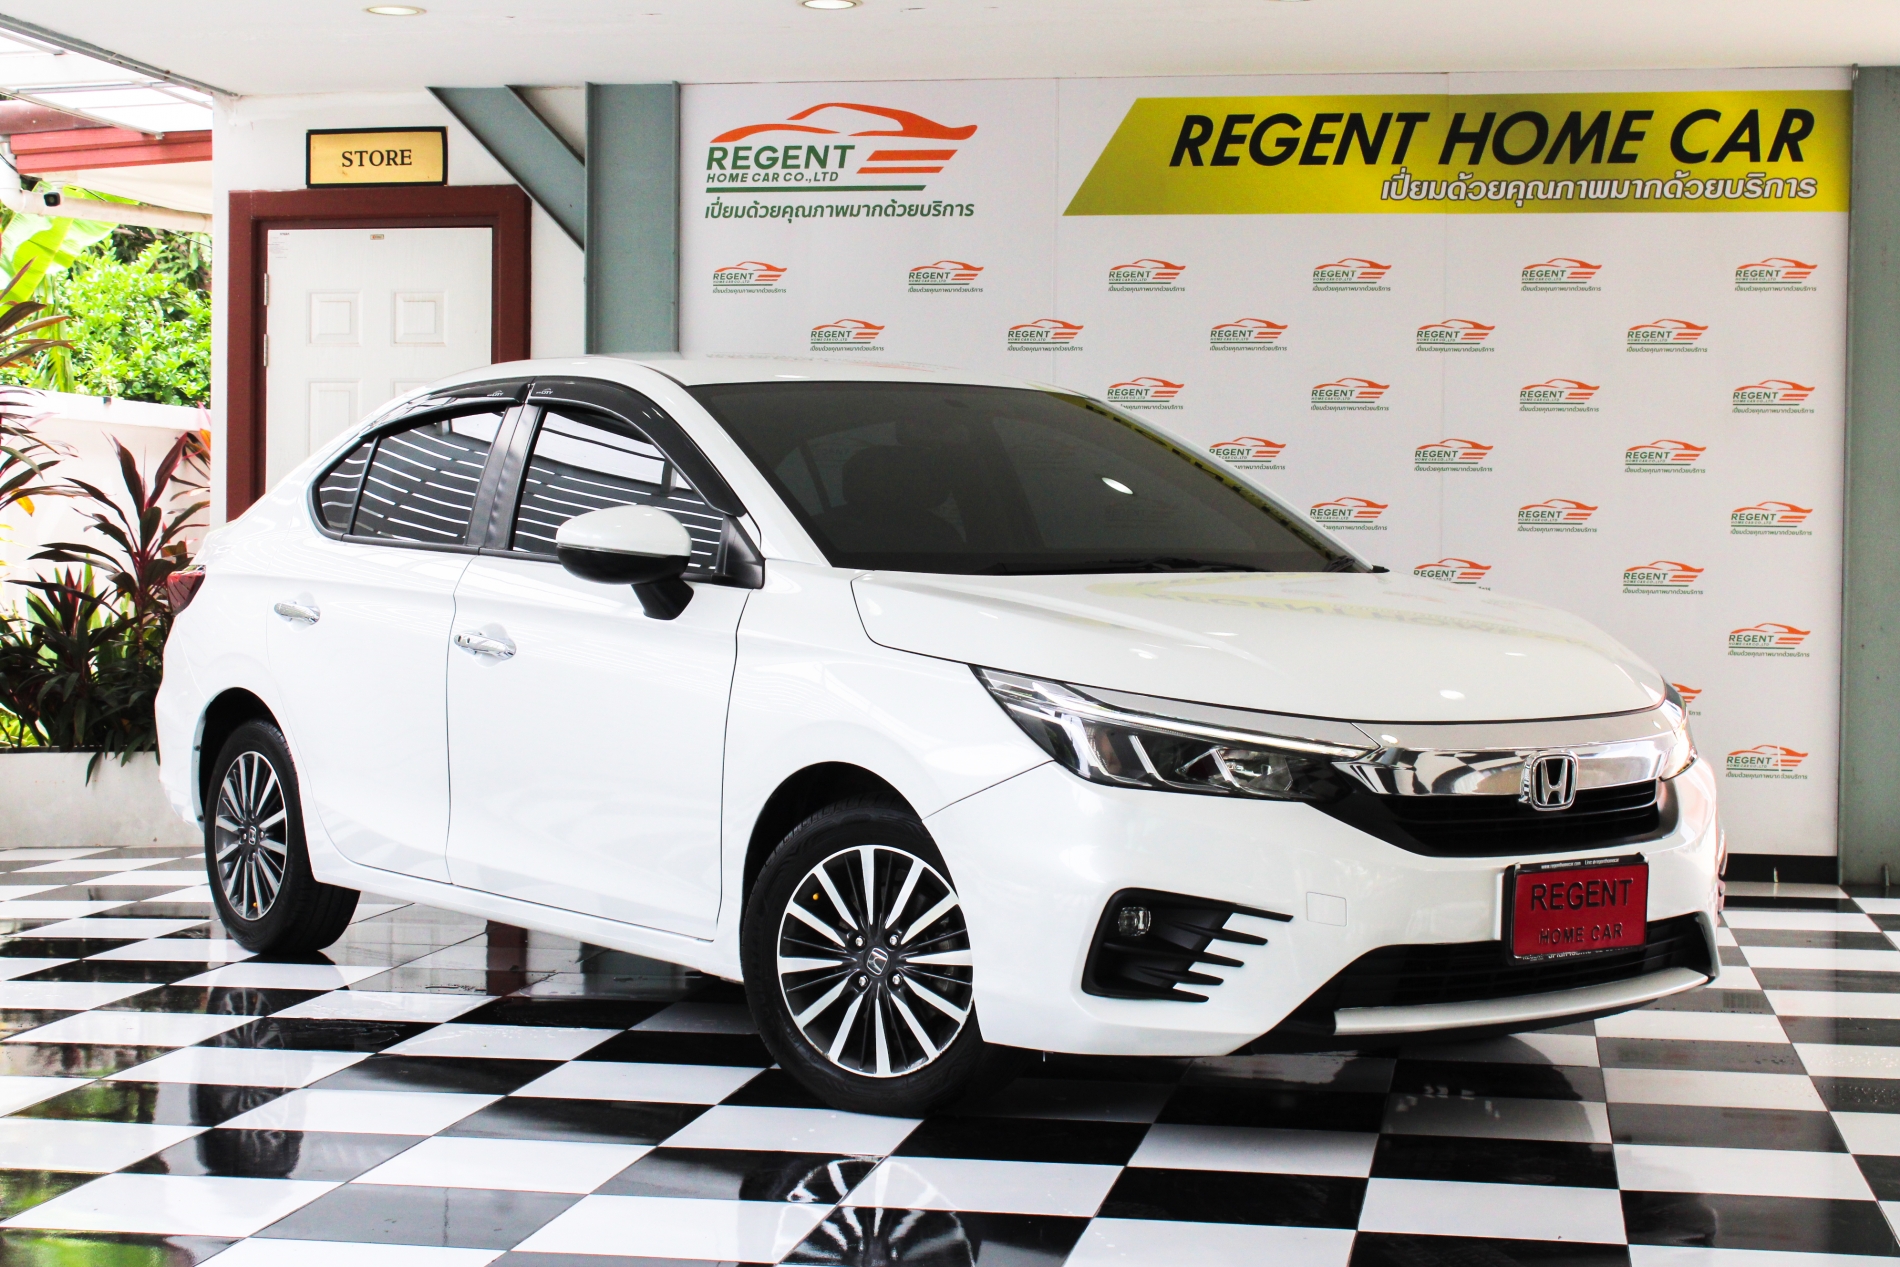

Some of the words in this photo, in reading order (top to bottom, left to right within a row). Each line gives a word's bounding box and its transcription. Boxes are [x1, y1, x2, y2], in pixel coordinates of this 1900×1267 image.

[1171, 113, 1431, 167] REGENT
[1440, 111, 1654, 166] HOME
[1671, 109, 1815, 164] CAR
[341, 149, 412, 167] STORE
[706, 144, 855, 170] REGENT
[706, 173, 748, 183] HOME
[752, 172, 780, 183] CAR
[783, 172, 839, 183] CO.,LTD
[1381, 168, 1817, 207] เปี่ยมด้วยคุณภาพมากด้วยบริการ
[705, 196, 975, 223] เปี่ยมด้วยคุณภาพมากด้วยบริการ
[1735, 269, 1781, 277] REGENT
[1008, 330, 1050, 338] REGENT
[1416, 330, 1460, 338] REGENT
[1627, 330, 1672, 338] REGENT
[1107, 388, 1150, 396] REGENT
[1311, 389, 1355, 397] REGENT
[1520, 390, 1564, 398] REGENT
[1733, 391, 1778, 399] REGENT
[1415, 450, 1458, 458] REGENT
[1625, 451, 1670, 459] REGENT
[1518, 510, 1562, 518] REGENT
[1731, 512, 1776, 521] REGENT
[1623, 572, 1668, 580] REGENT
[1729, 634, 1774, 642] REGENT
[1726, 755, 1772, 764] REGENT
[1531, 878, 1633, 911] REGENT
[1539, 927, 1585, 945] HOME
[1591, 922, 1623, 942] CAR
